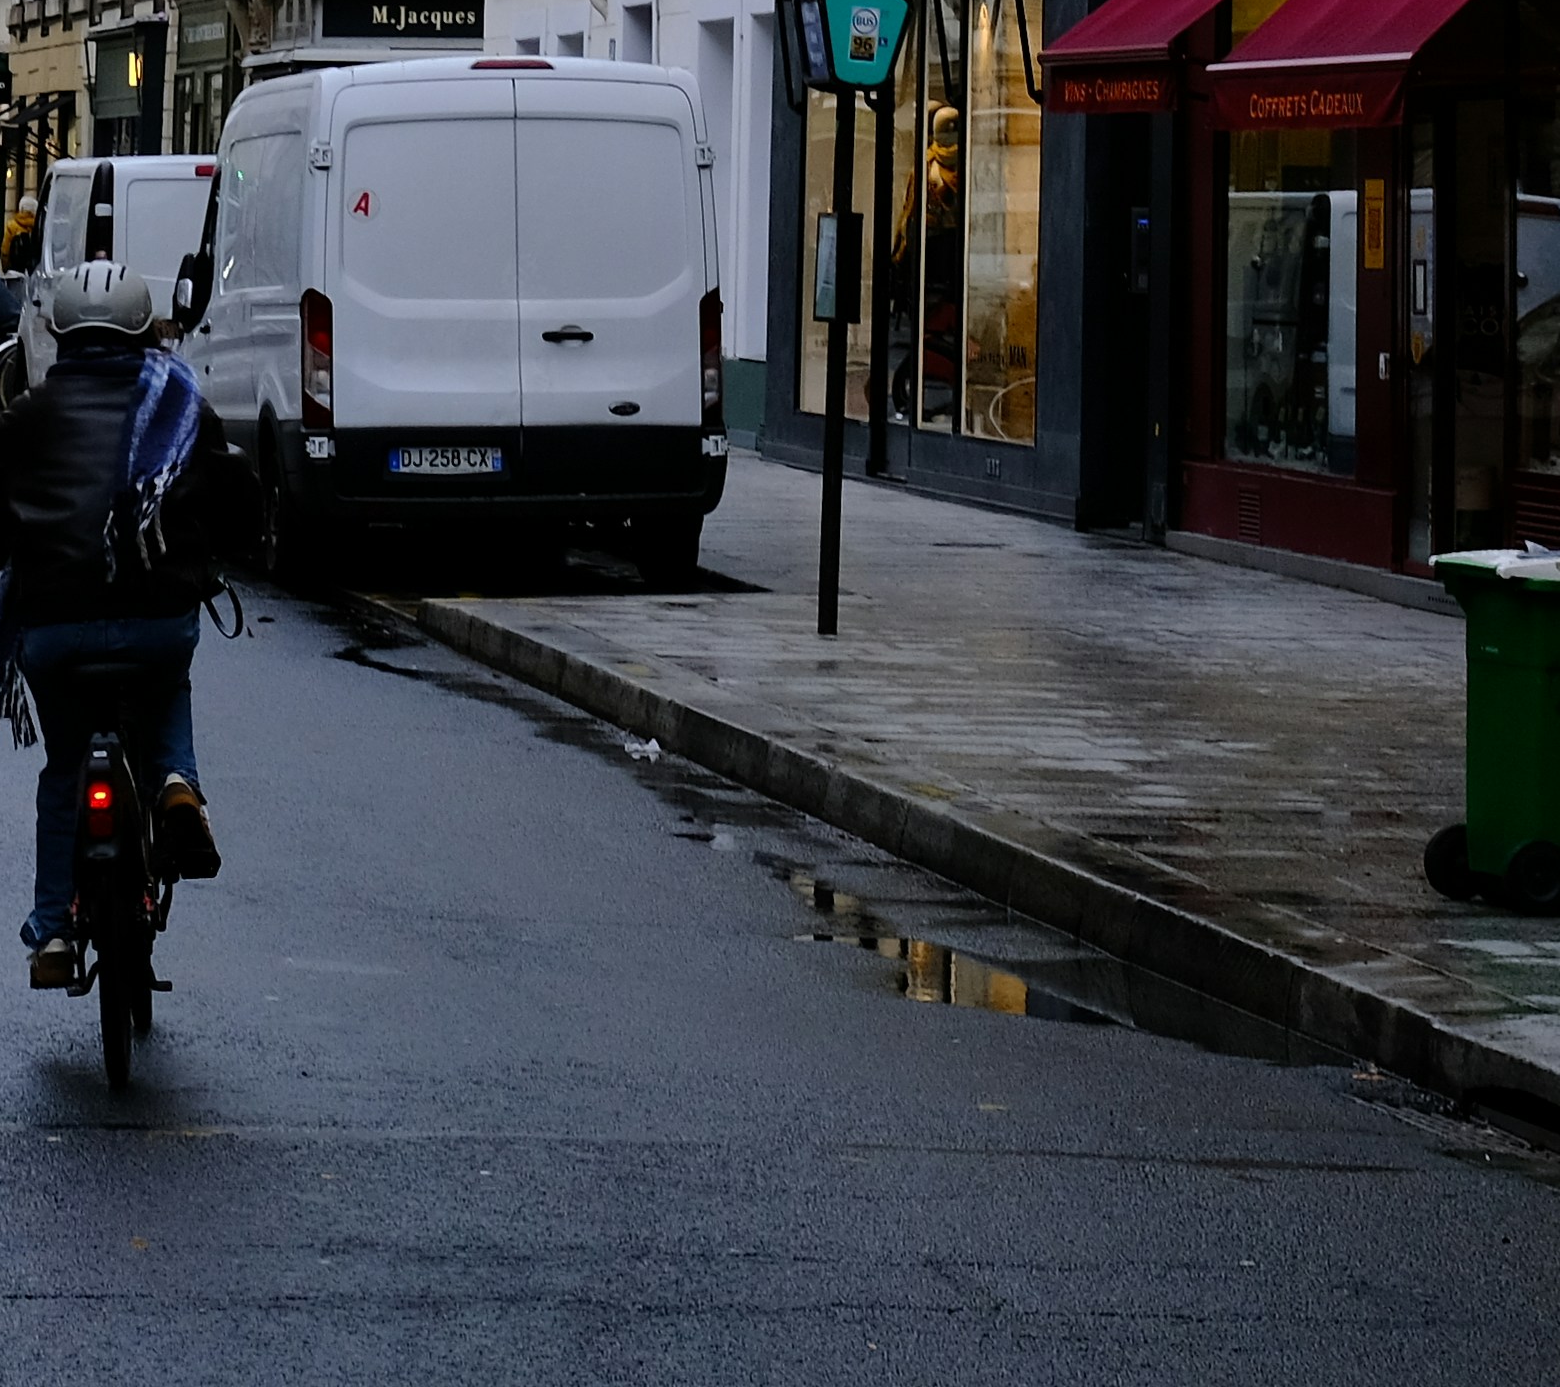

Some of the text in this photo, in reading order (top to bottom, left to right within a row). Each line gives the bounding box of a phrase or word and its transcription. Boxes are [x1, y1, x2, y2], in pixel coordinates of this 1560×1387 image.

[371, 4, 476, 31] M.Jacques
[856, 16, 874, 26] BUS
[853, 37, 873, 51] 96
[1249, 89, 1364, 119] COFFRETS CADEAUX
